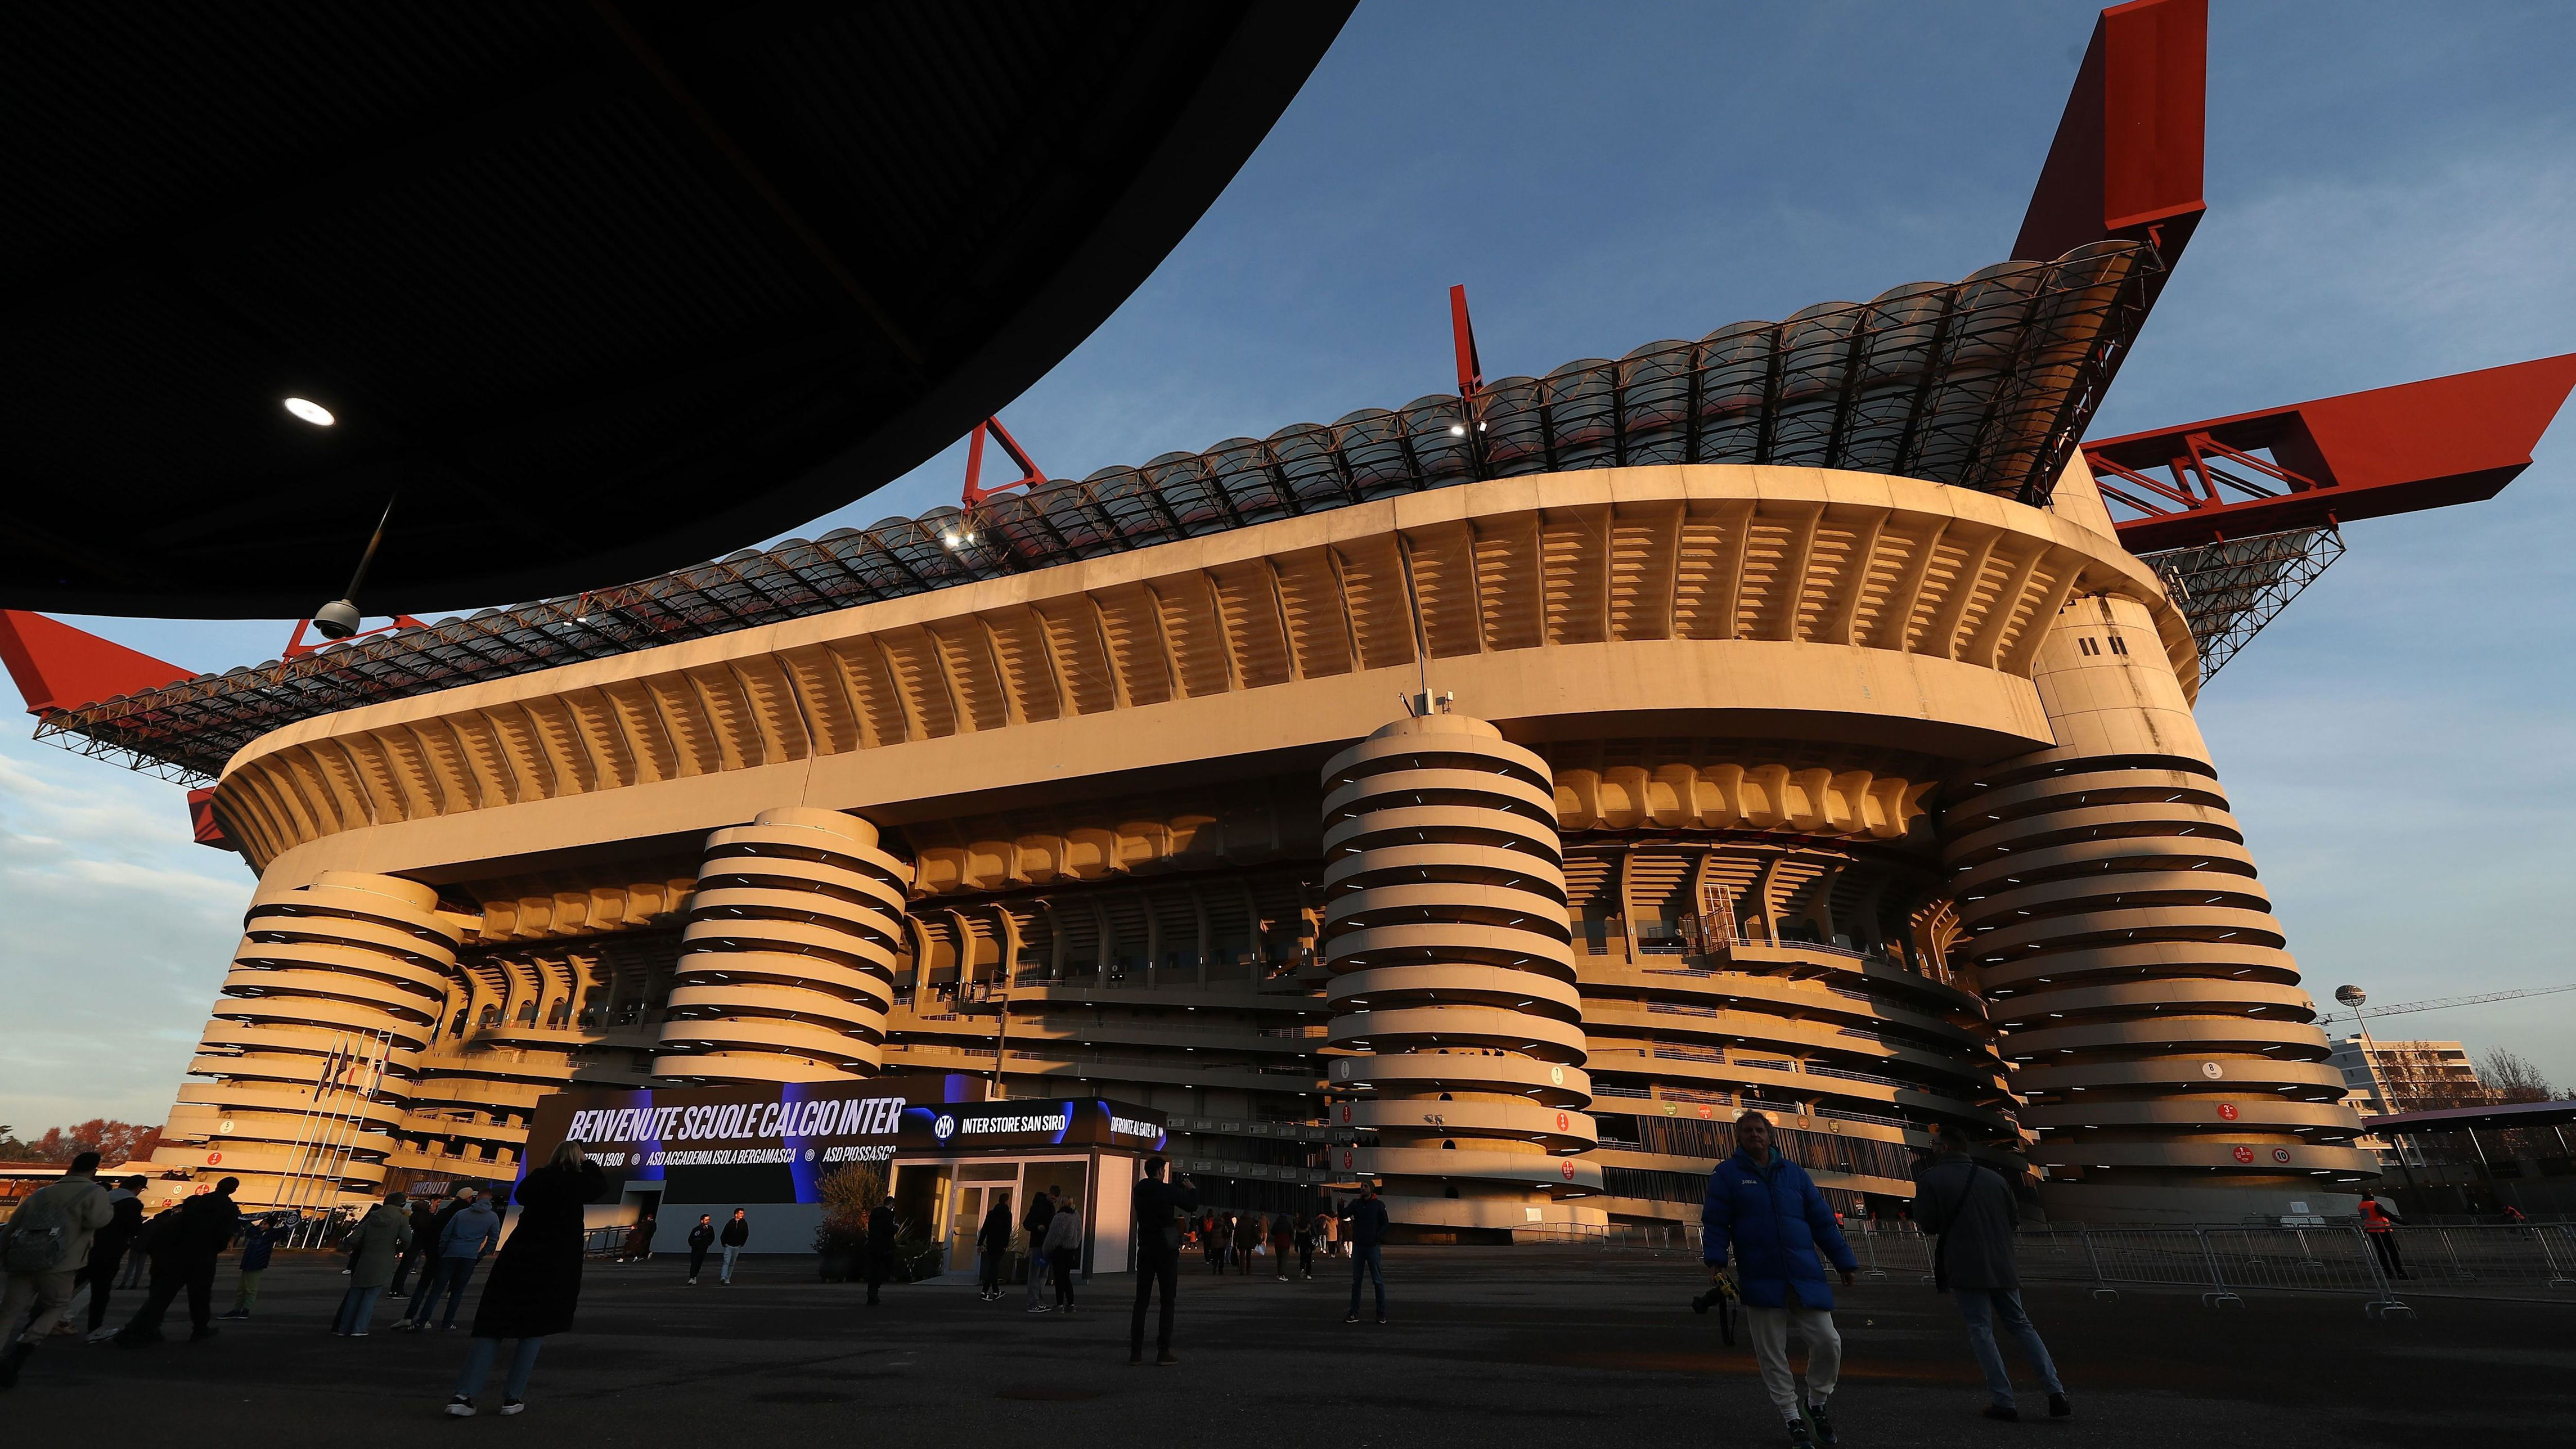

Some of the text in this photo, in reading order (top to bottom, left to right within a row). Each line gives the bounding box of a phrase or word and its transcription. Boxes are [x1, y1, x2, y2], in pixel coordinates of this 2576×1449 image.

[565, 1097, 906, 1142] BENVENUTE SCUOLE CALCIO INTER
[962, 1114, 1066, 1133] INTER STORE SAN SIRO
[1132, 1120, 1139, 1136] AL
[1139, 1122, 1152, 1138] GATE
[1150, 1124, 1157, 1138] 14
[585, 1152, 626, 1167] TRIA 1908
[645, 1148, 797, 1166] ASD ACCADEMIA ISOLA BERGAMASCA
[822, 1147, 844, 1162] ASD
